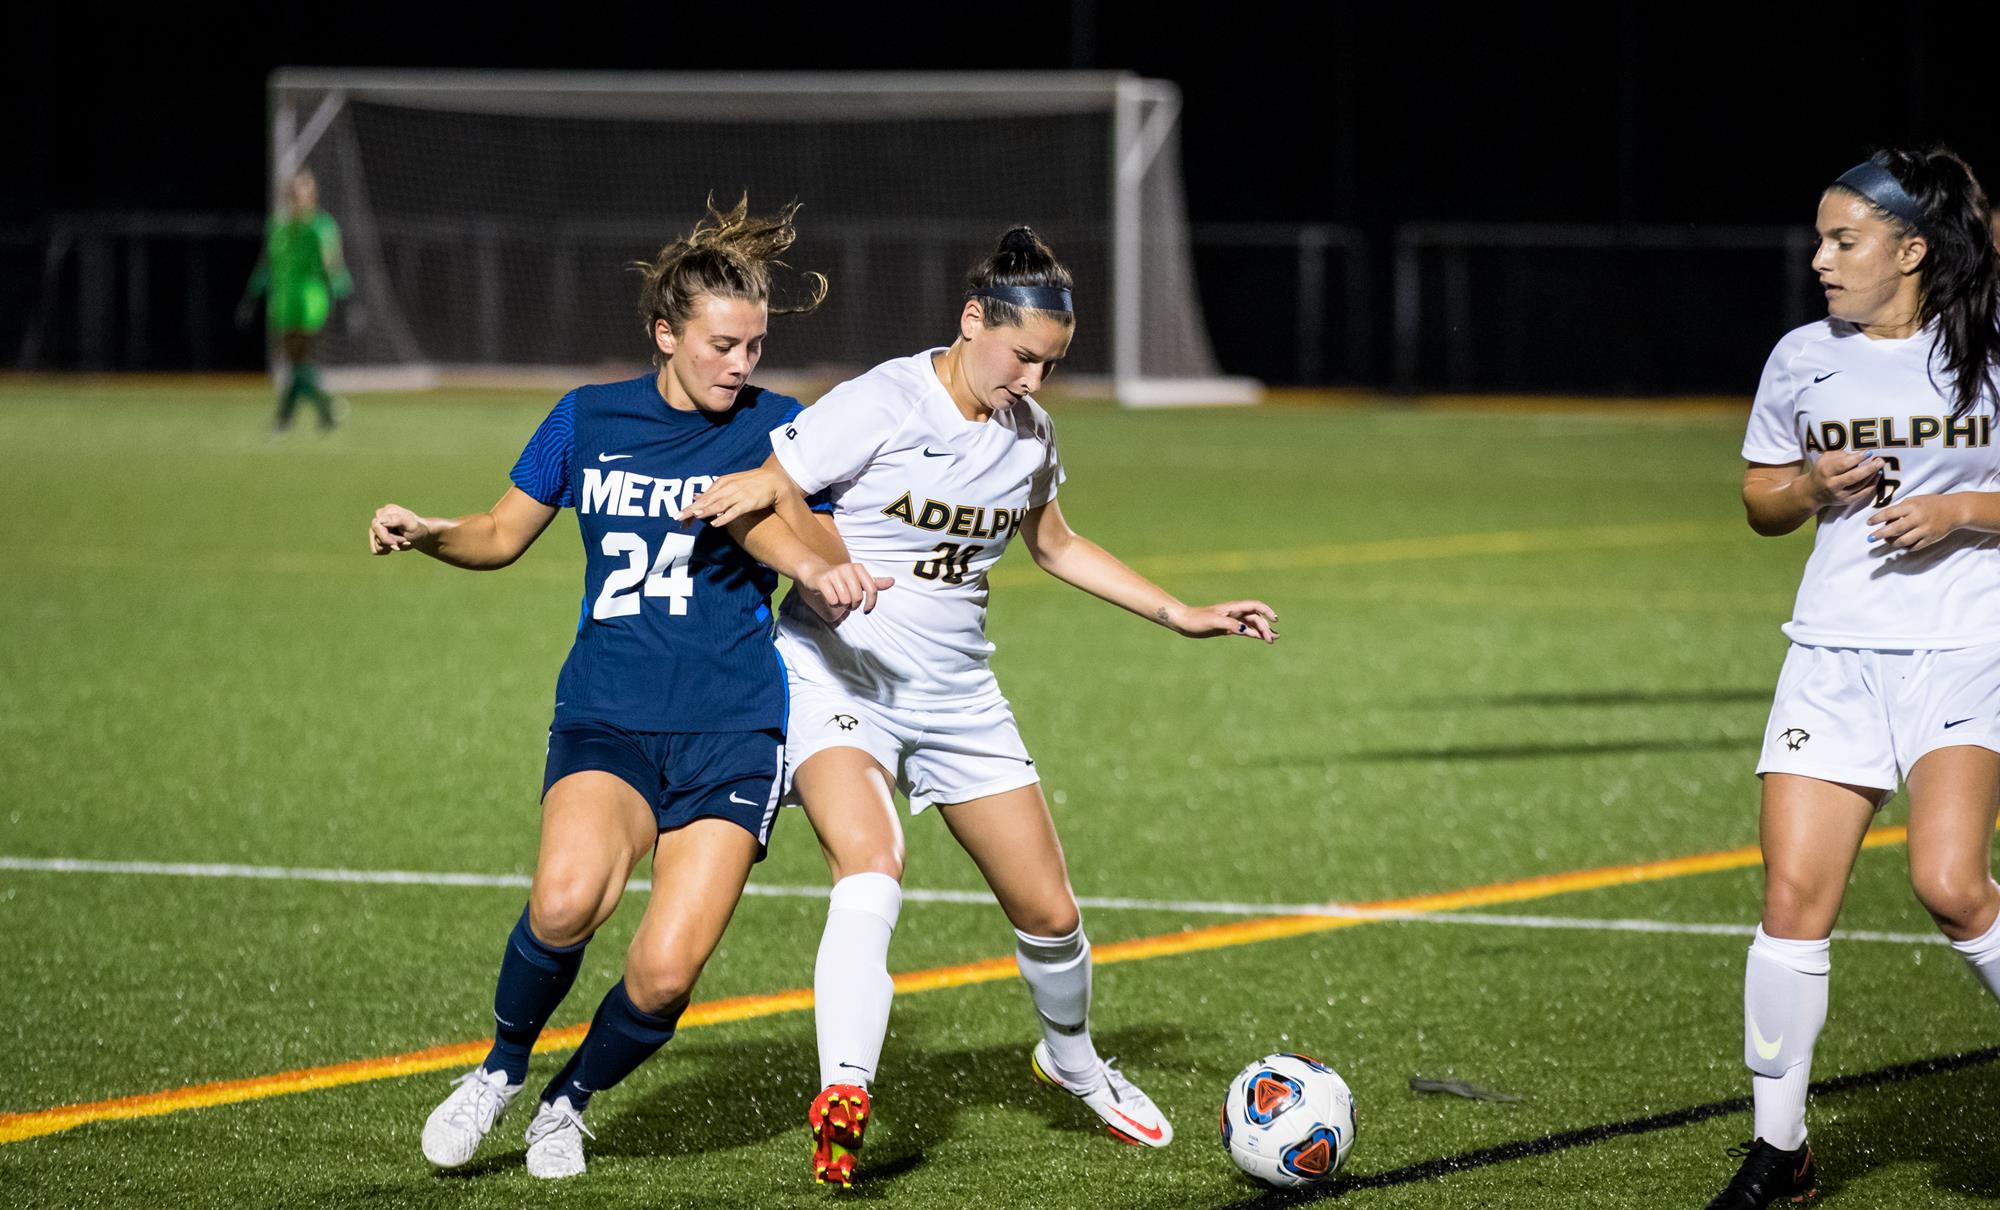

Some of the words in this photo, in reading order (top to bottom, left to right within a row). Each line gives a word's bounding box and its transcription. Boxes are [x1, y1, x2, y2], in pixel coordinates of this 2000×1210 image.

[1805, 414, 1991, 453] ADELPHI
[581, 468, 720, 520] MERC
[1870, 456, 1901, 508] 6
[593, 531, 696, 620] 24
